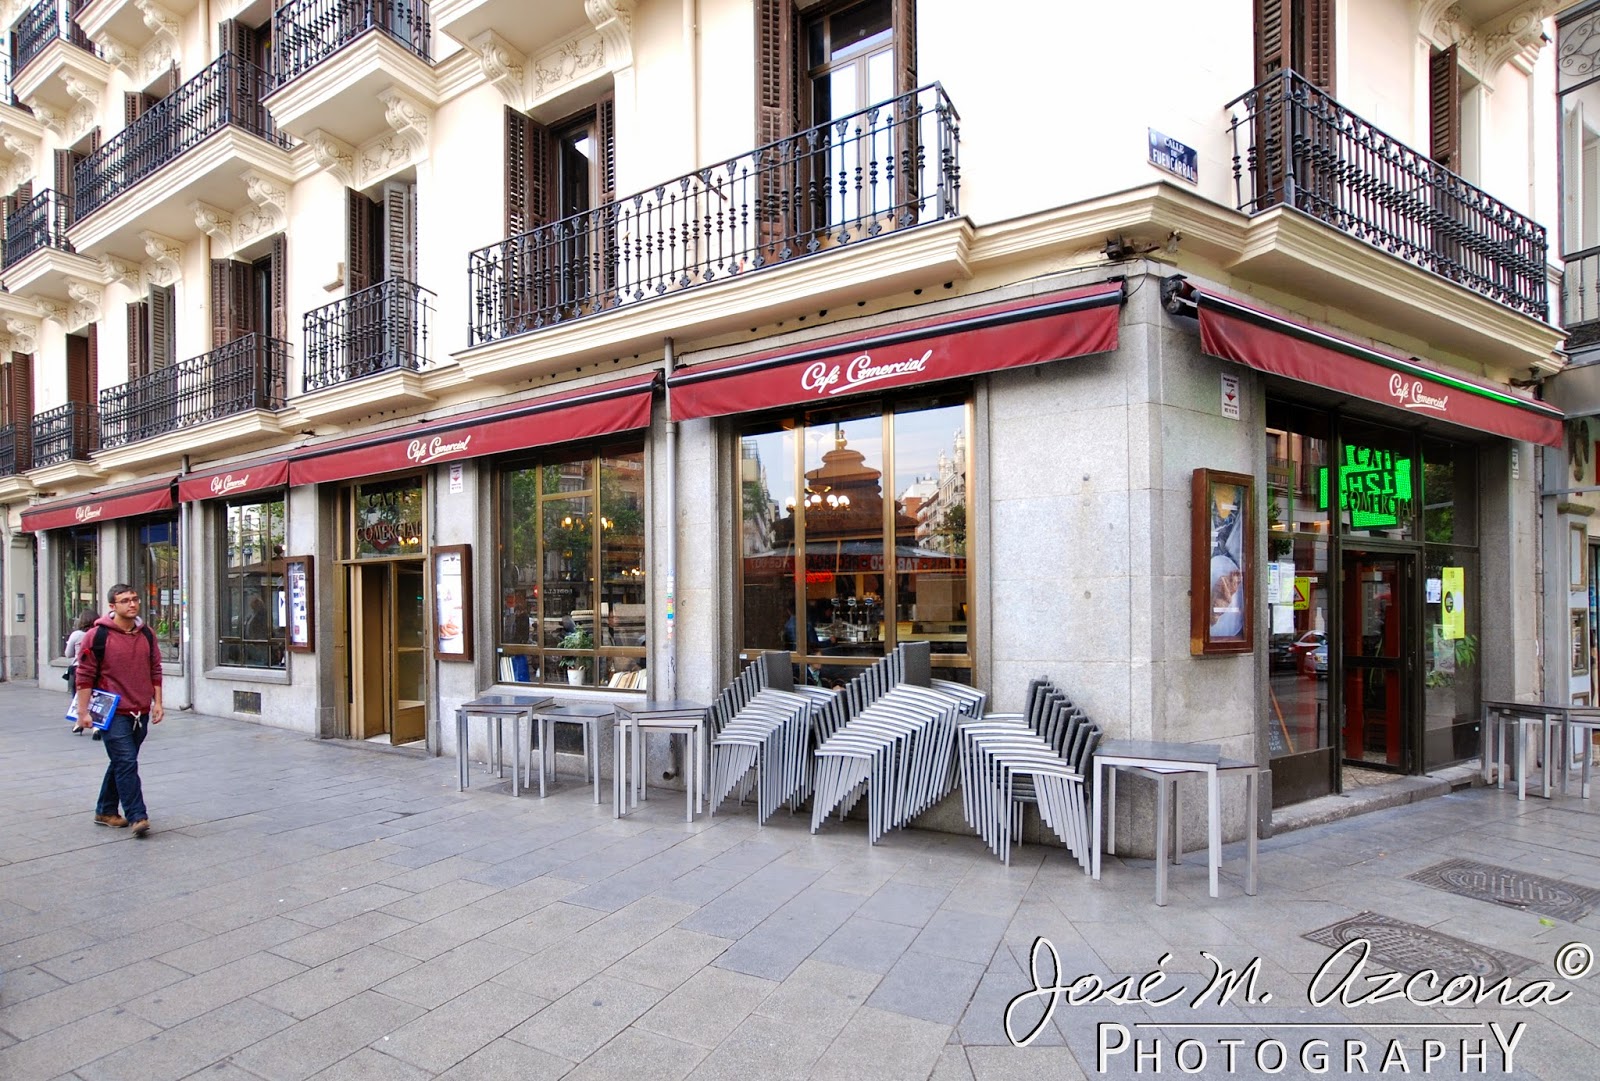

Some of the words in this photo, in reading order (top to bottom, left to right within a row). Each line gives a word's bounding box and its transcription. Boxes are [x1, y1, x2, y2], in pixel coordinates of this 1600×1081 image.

[1164, 137, 1184, 154] CALLE
[1152, 148, 1195, 180] FUENCARRAL
[801, 361, 840, 393] Café
[846, 349, 933, 384] Comercial
[1389, 373, 1409, 403] Café
[1411, 381, 1449, 411] Comercial
[429, 434, 471, 456] Comercial
[355, 521, 422, 542] COMERCIAL
